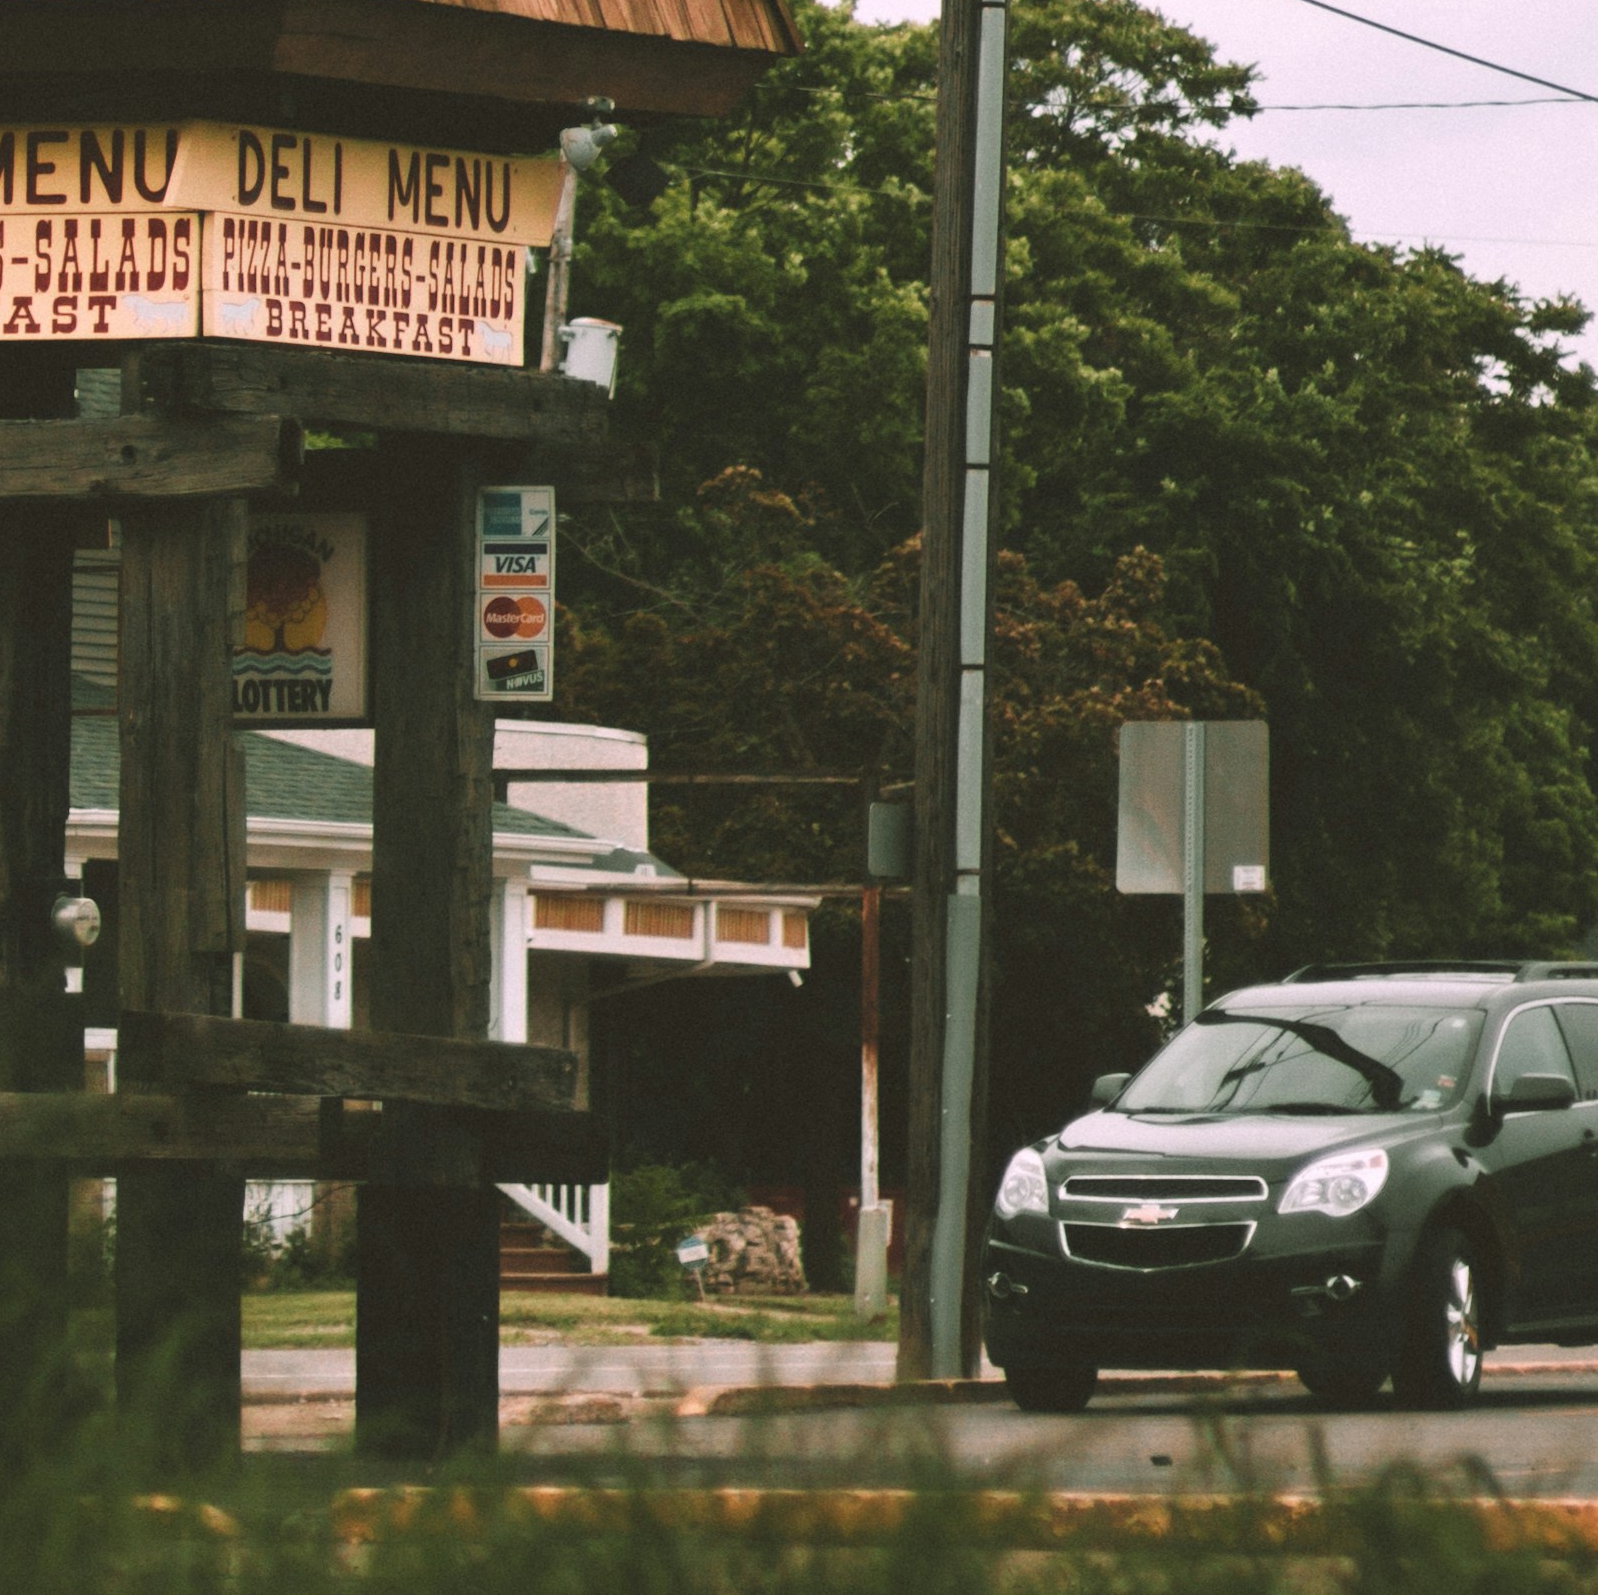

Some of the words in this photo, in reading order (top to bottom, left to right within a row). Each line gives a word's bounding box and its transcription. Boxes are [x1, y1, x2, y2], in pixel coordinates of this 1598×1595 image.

[237, 129, 342, 216] DELI
[387, 147, 510, 233] MENU
[265, 297, 475, 356] BREAKFAST
[495, 555, 537, 573] VISA
[485, 612, 545, 624] MasterCard
[233, 678, 333, 713] LOTTERY
